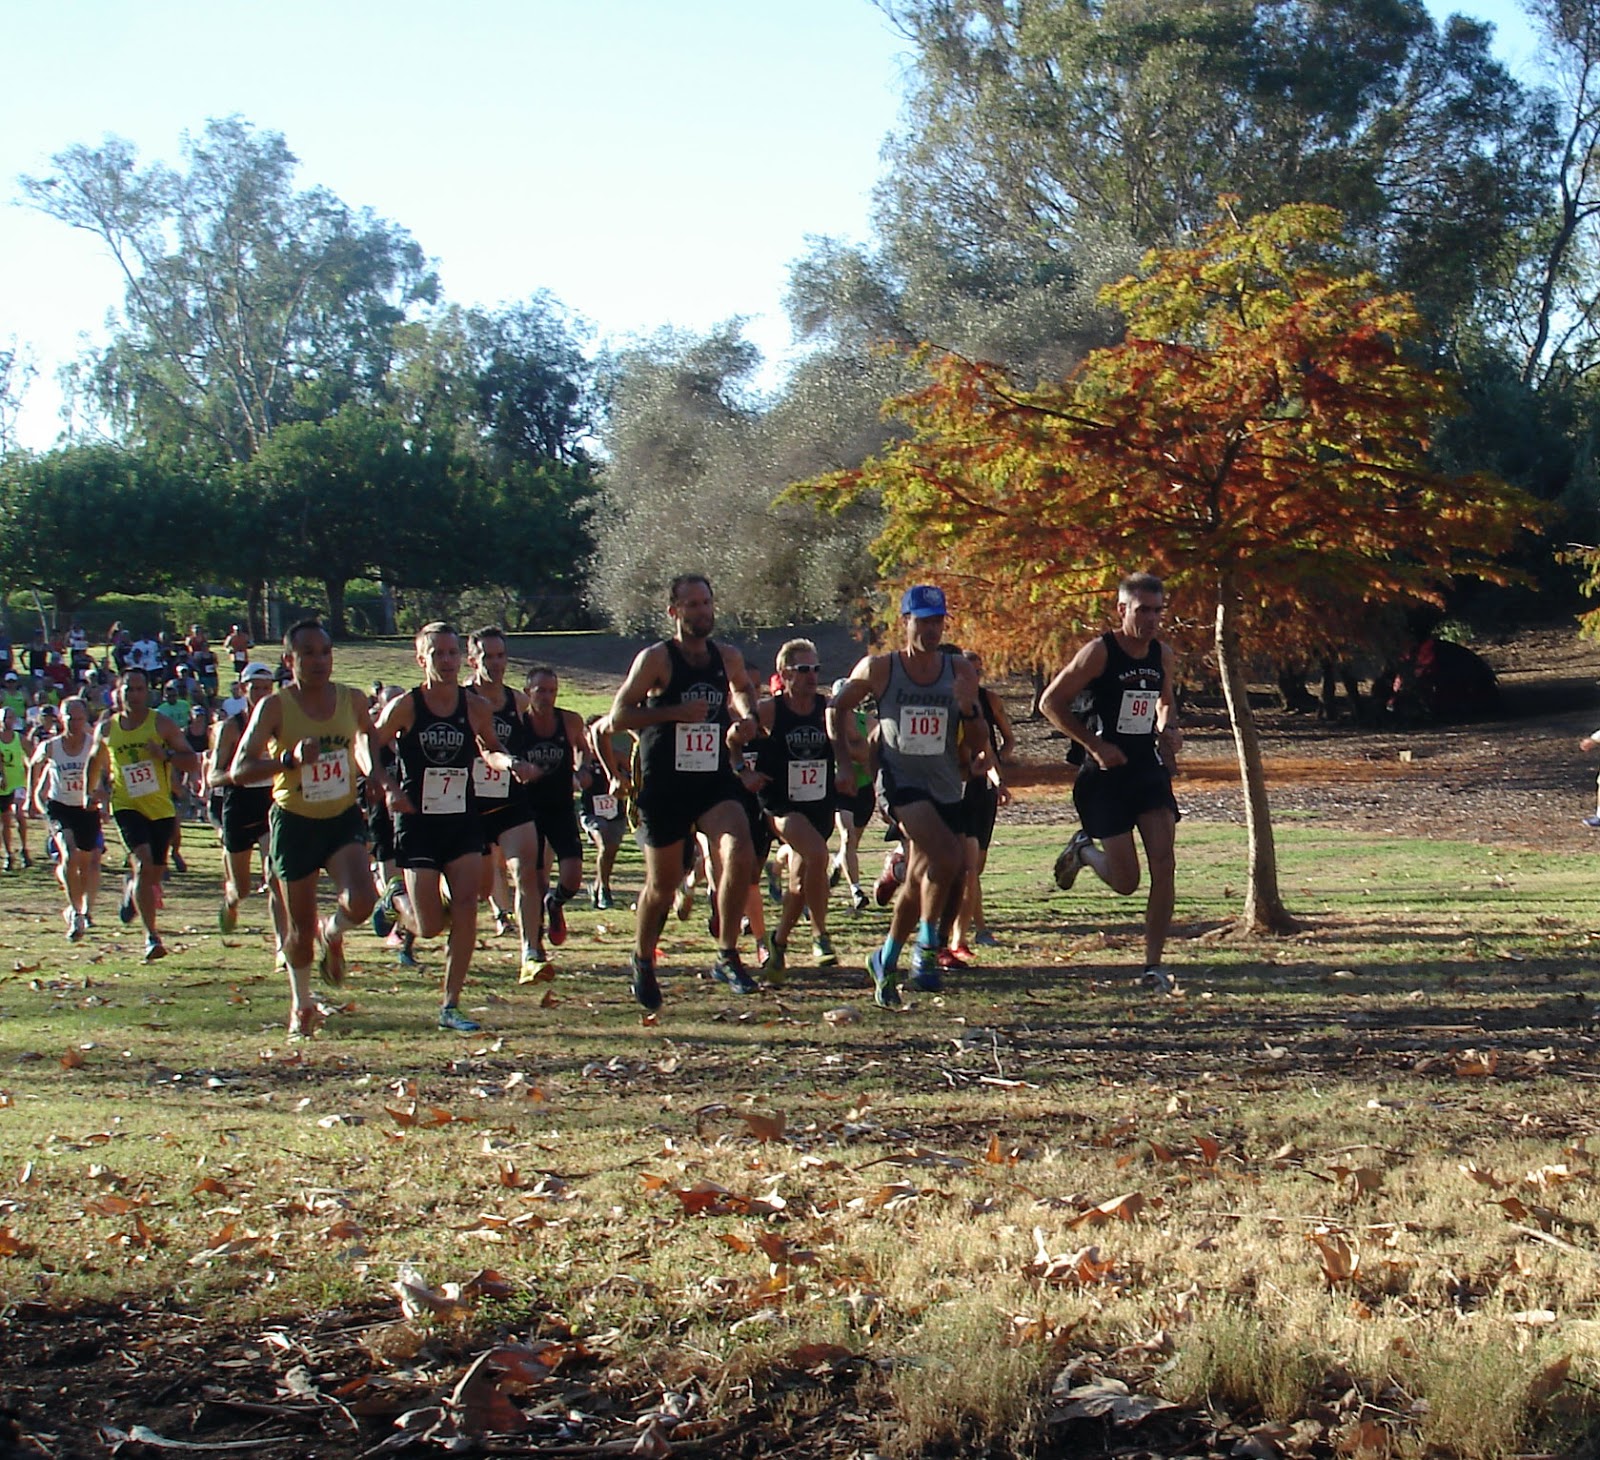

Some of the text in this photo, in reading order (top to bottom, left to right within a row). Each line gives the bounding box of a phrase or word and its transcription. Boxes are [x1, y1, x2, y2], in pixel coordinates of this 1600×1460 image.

[1119, 670, 1136, 680] SAN
[1132, 700, 1148, 716] 98
[911, 716, 940, 735] 103
[419, 731, 465, 747] PRADO
[686, 733, 714, 752] 112
[785, 732, 826, 744] PRADO
[527, 749, 565, 762] PRADO
[129, 768, 152, 784] 153
[312, 761, 342, 783] 134
[801, 769, 817, 785] 12
[443, 777, 451, 794] 7
